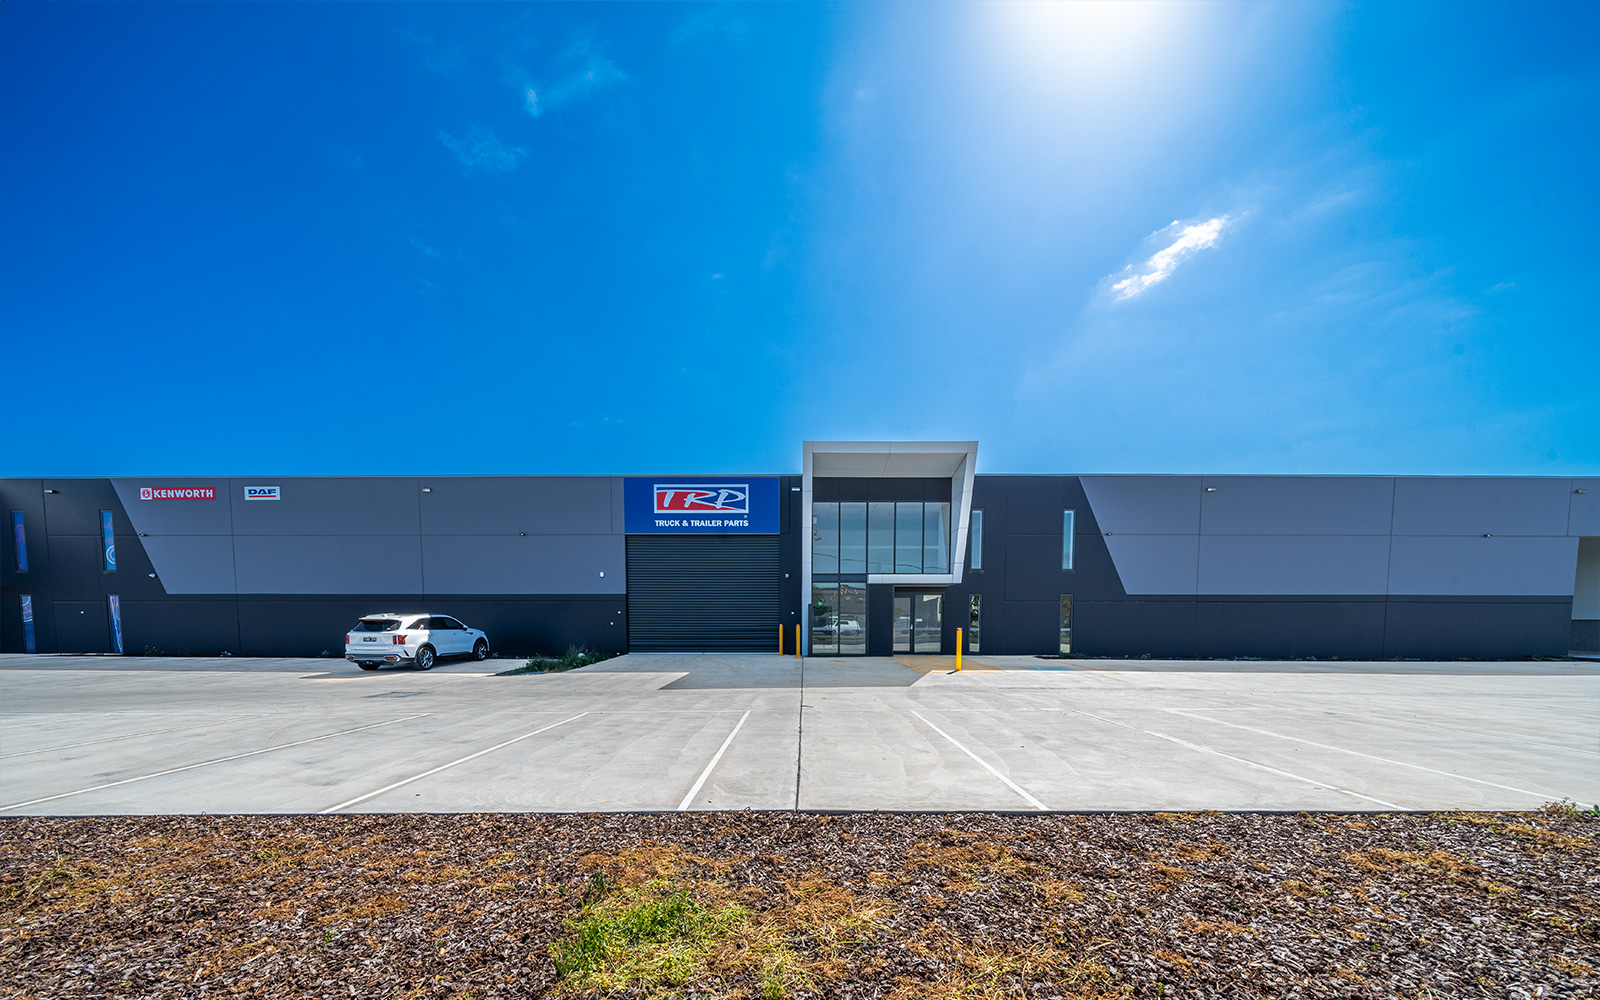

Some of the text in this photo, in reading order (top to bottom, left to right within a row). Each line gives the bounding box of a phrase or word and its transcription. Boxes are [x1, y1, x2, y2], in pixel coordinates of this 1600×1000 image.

[153, 489, 213, 498] KENWORTH
[656, 489, 746, 511] TRP
[655, 519, 749, 527] TRUCK & TRAILER PARTS
